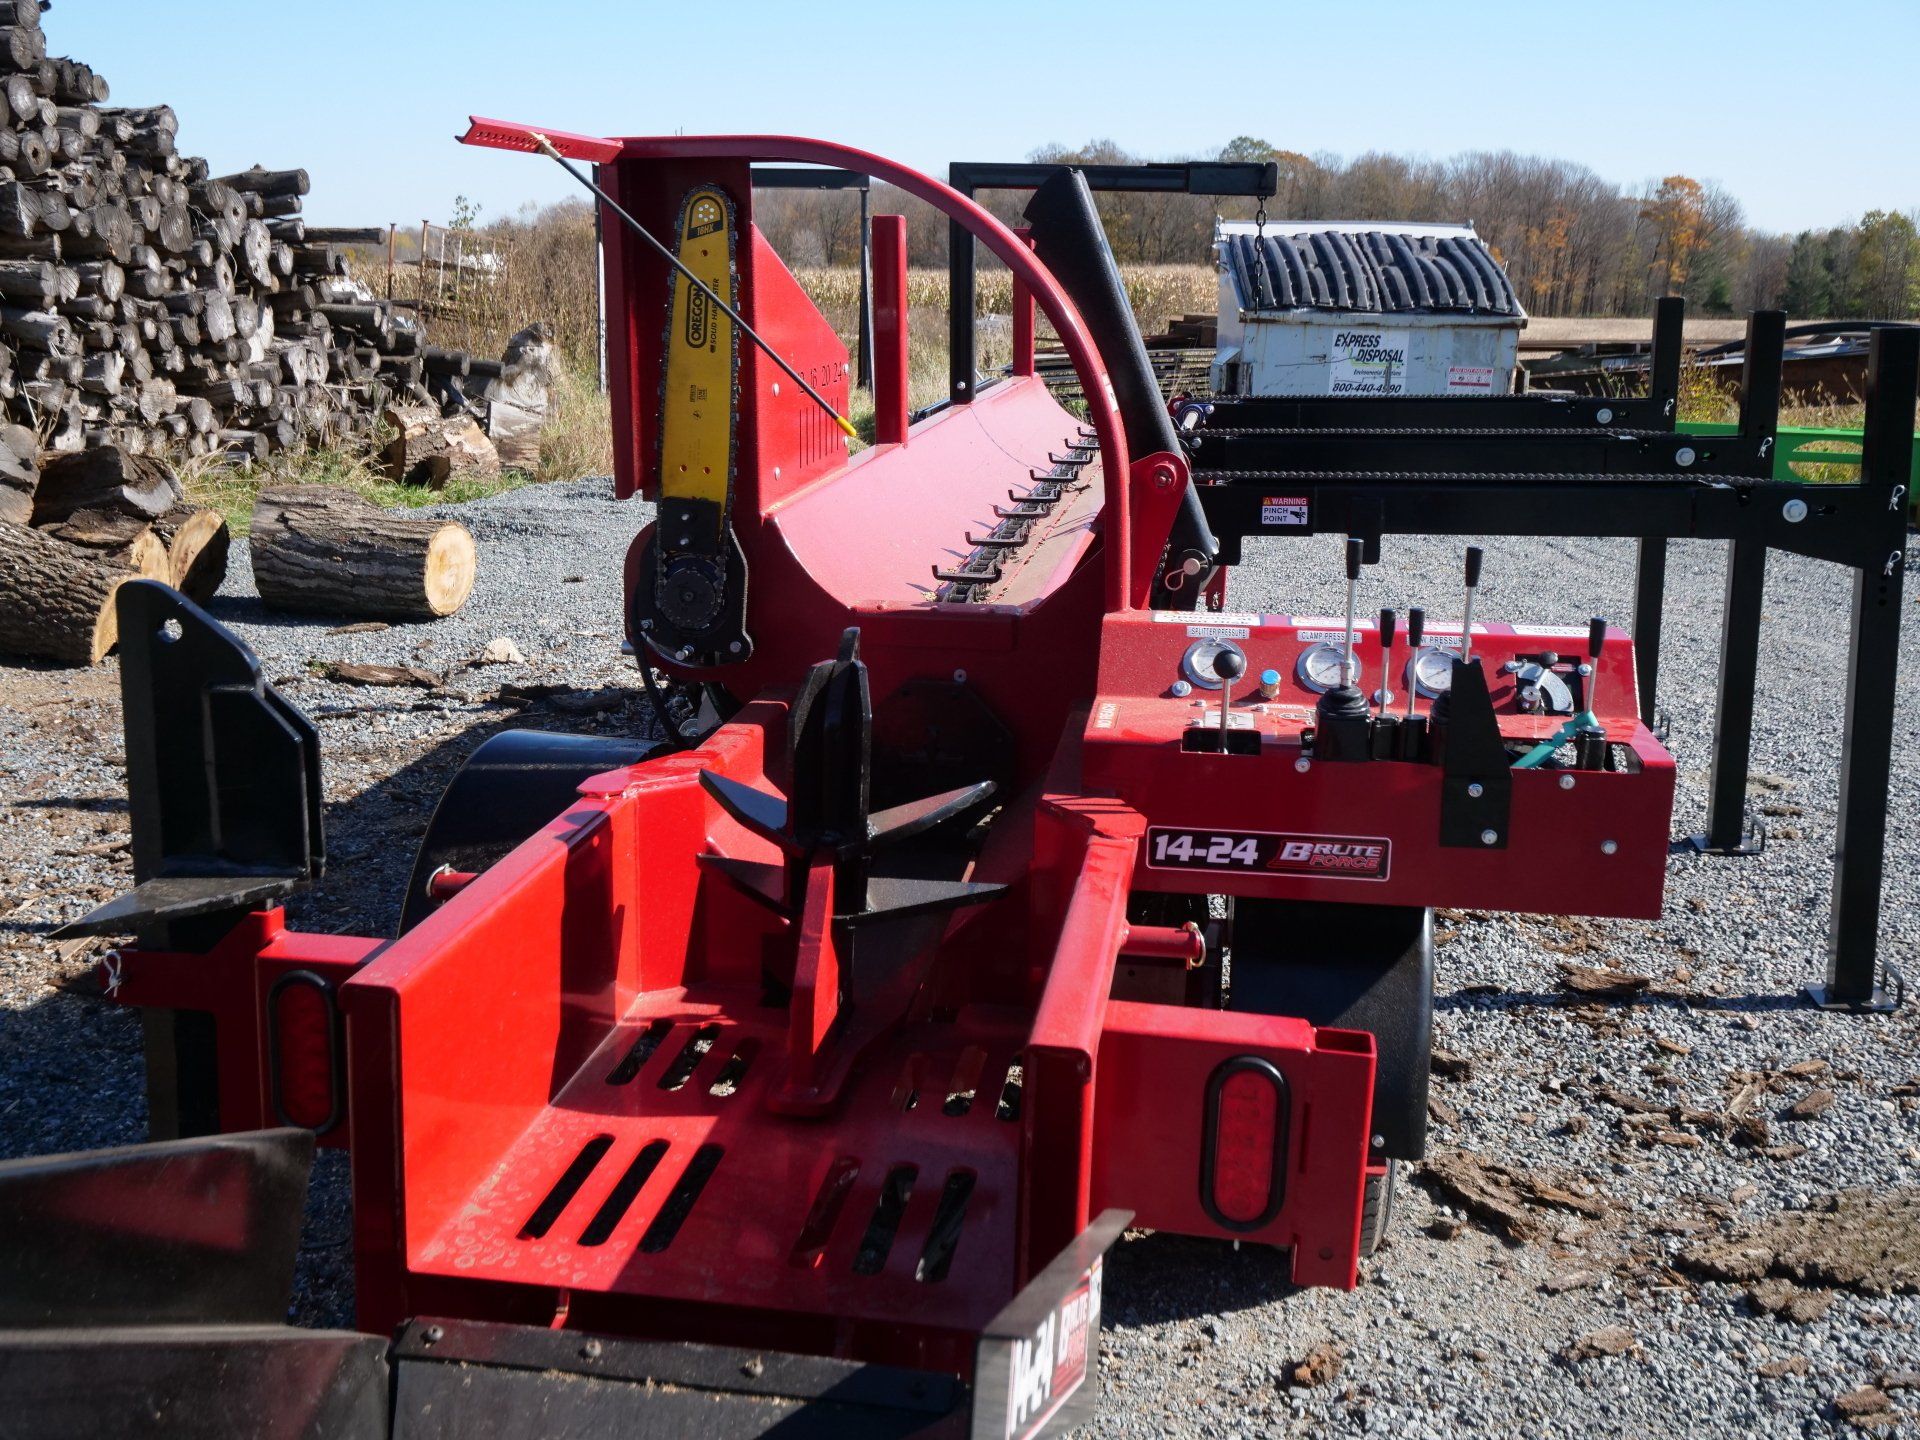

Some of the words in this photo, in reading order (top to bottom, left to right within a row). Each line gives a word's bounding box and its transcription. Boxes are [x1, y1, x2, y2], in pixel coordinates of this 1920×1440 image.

[712, 278, 720, 321] HARSTER
[690, 287, 703, 342] OREGON
[710, 322, 718, 344] SOLID
[1334, 332, 1381, 351] EXPRESS
[1355, 349, 1404, 362] DISPOSAL
[821, 364, 831, 386] 20
[833, 361, 842, 382] 24
[1272, 498, 1307, 506] WARNING
[1191, 628, 1216, 636] SPLITTER
[1217, 629, 1246, 637] PRESSURE
[1301, 632, 1322, 640] CLAMP
[1325, 633, 1358, 642] PRESSE
[1429, 636, 1464, 645] PRESSUR
[1155, 834, 1258, 865] 14-24
[1280, 842, 1383, 861] BRUTE
[1309, 855, 1381, 869] FORCE
